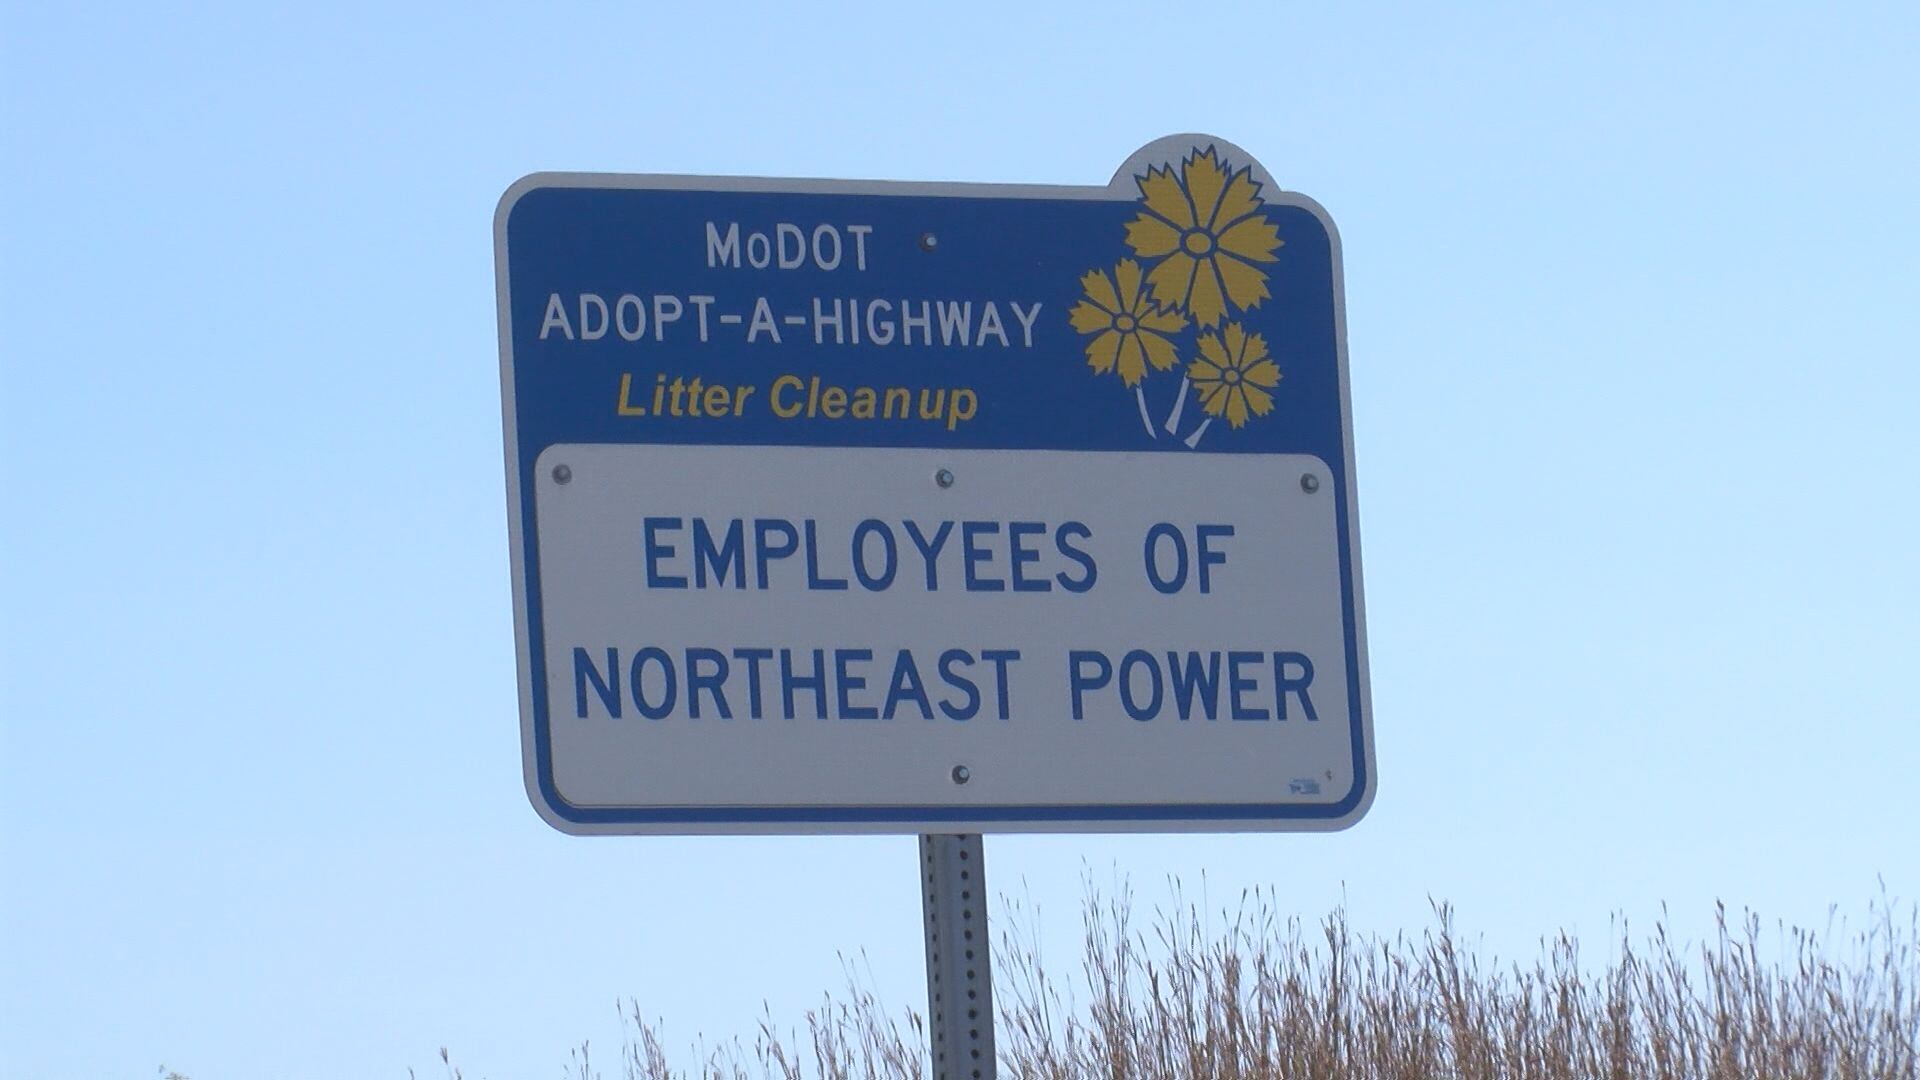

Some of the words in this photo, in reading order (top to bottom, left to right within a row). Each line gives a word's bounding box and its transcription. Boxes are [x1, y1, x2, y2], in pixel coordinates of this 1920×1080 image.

[706, 221, 873, 271] MoDOT
[539, 293, 1043, 348] ADOPT-A-HIGHWAY
[617, 373, 755, 418] Litter
[770, 374, 978, 431] Cleanup
[643, 516, 1098, 594] EMPLOYEES
[1144, 522, 1235, 595] OF
[573, 646, 1021, 722] NORTHEAST
[1068, 649, 1319, 722] POWER
